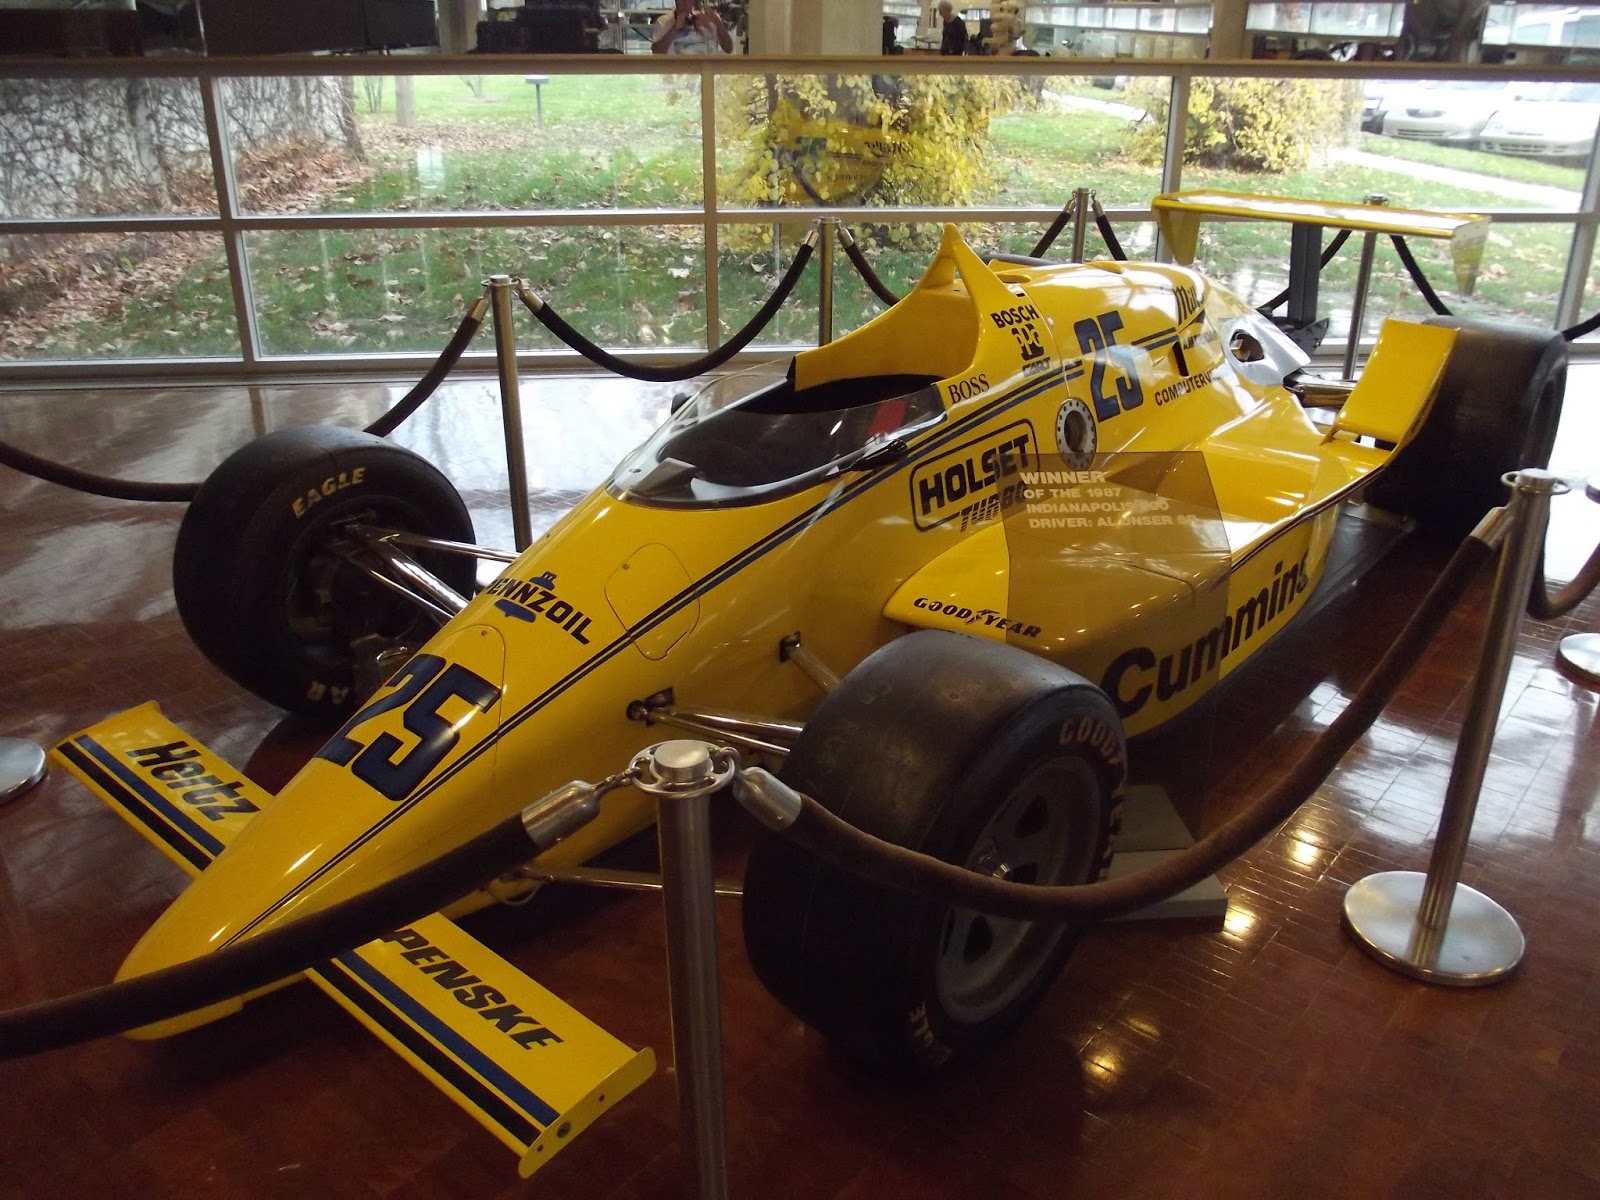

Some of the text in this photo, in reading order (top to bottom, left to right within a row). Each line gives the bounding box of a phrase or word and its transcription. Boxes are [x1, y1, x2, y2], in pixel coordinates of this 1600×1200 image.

[990, 304, 1040, 329] BOSCH
[1171, 285, 1205, 326] Mill
[1073, 310, 1144, 423] 25
[1154, 368, 1219, 407] COMPUTERV
[947, 373, 990, 404] BOSS
[291, 467, 366, 519] EAGLE
[919, 433, 1029, 516] HOLSET
[1020, 470, 1106, 485] WINNER
[1023, 486, 1122, 500] OF THE 1987
[1026, 501, 1135, 514] INDIANAPOLIS
[1029, 516, 1093, 529] DRIVER:
[1097, 516, 1119, 527] AL
[1122, 514, 1174, 526] UNSER
[486, 577, 592, 645] ENNZOIL
[913, 596, 1042, 639] GOODYEAR
[1100, 547, 1309, 719] Cummins
[312, 653, 502, 802] 25
[125, 740, 262, 822] Hertz
[381, 928, 565, 1051] PENSKE
